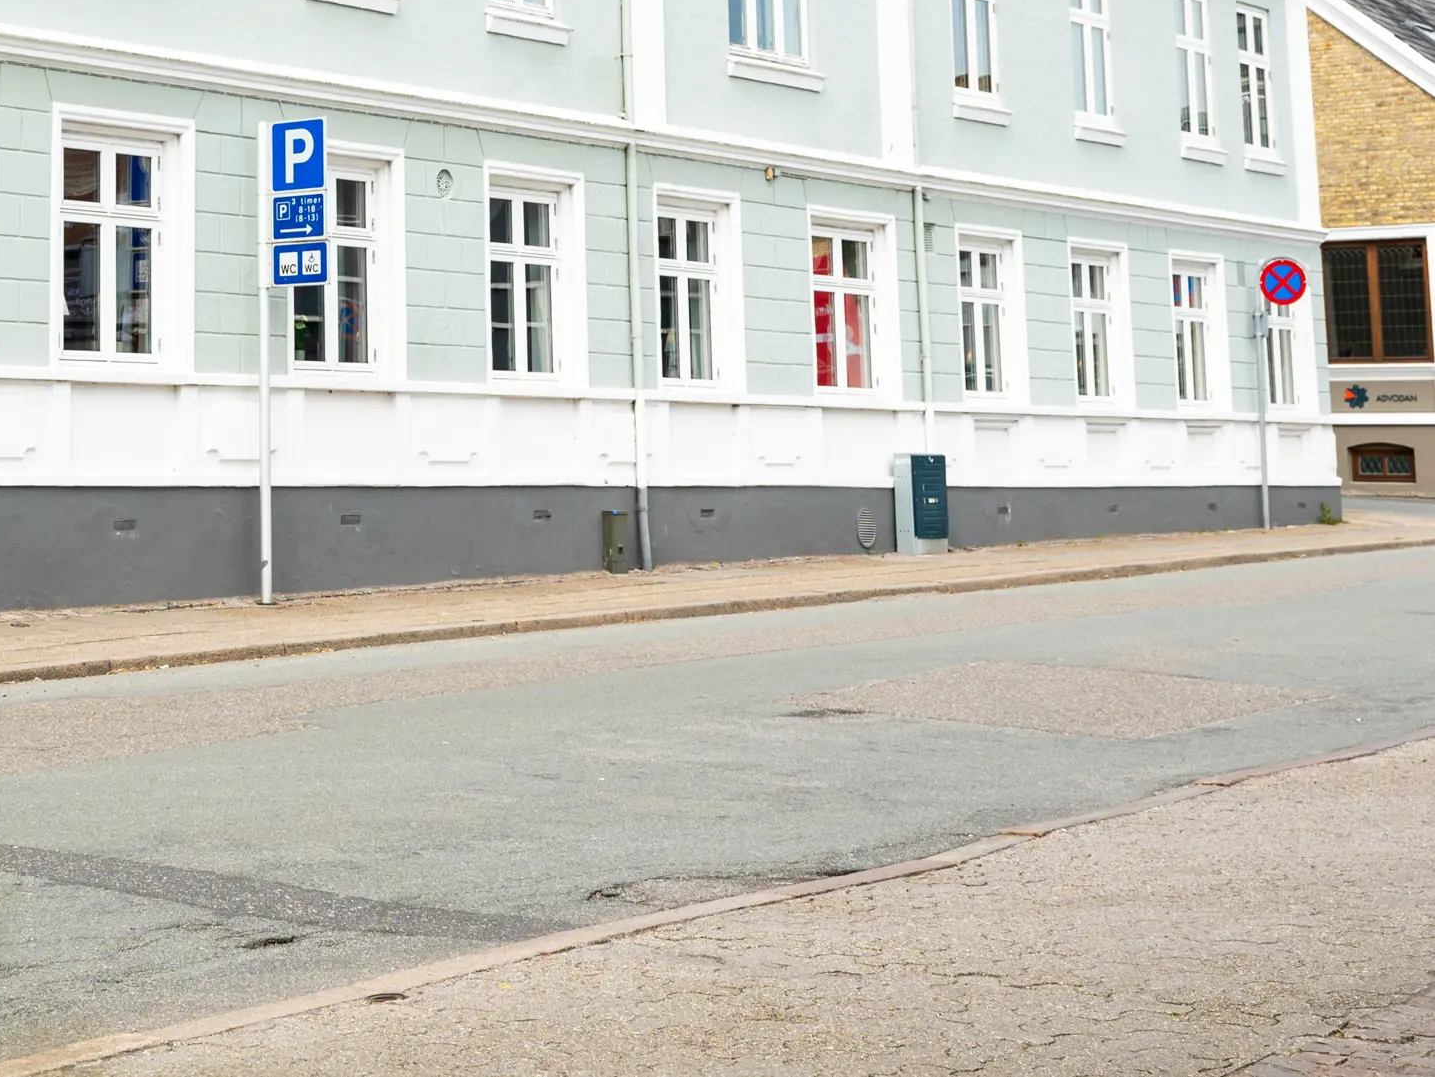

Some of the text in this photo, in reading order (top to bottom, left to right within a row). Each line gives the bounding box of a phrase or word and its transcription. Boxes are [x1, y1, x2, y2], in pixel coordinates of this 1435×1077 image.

[285, 128, 314, 184] P
[291, 197, 322, 205] 3 timer
[279, 204, 288, 218] P
[280, 263, 297, 275] WC
[304, 263, 319, 273] WC
[1376, 394, 1417, 402] ADVODAN
